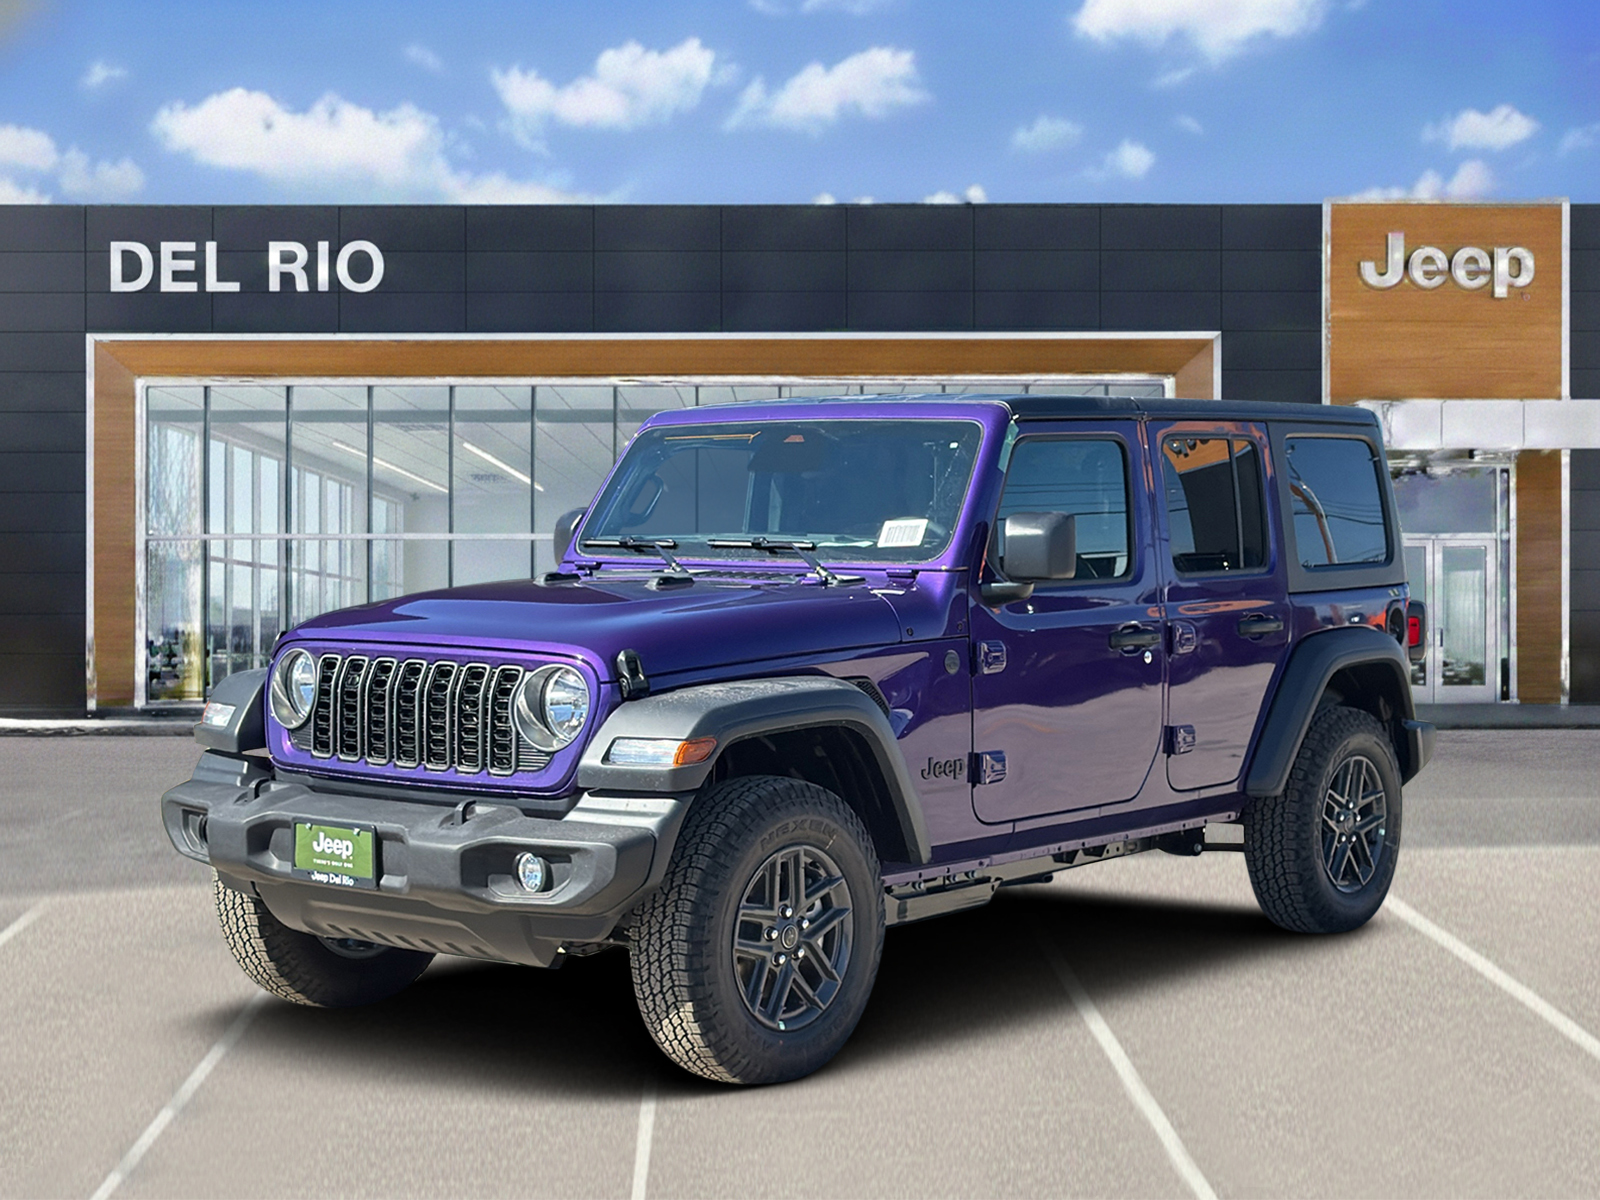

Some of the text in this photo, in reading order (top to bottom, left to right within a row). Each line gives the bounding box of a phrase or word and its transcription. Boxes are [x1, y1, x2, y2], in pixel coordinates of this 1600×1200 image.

[109, 239, 385, 293] DEL RIO
[1359, 231, 1535, 299] Jeep
[920, 756, 965, 780] Jeep
[312, 832, 353, 858] Jeep
[311, 871, 354, 886] Jeep Del Rio
